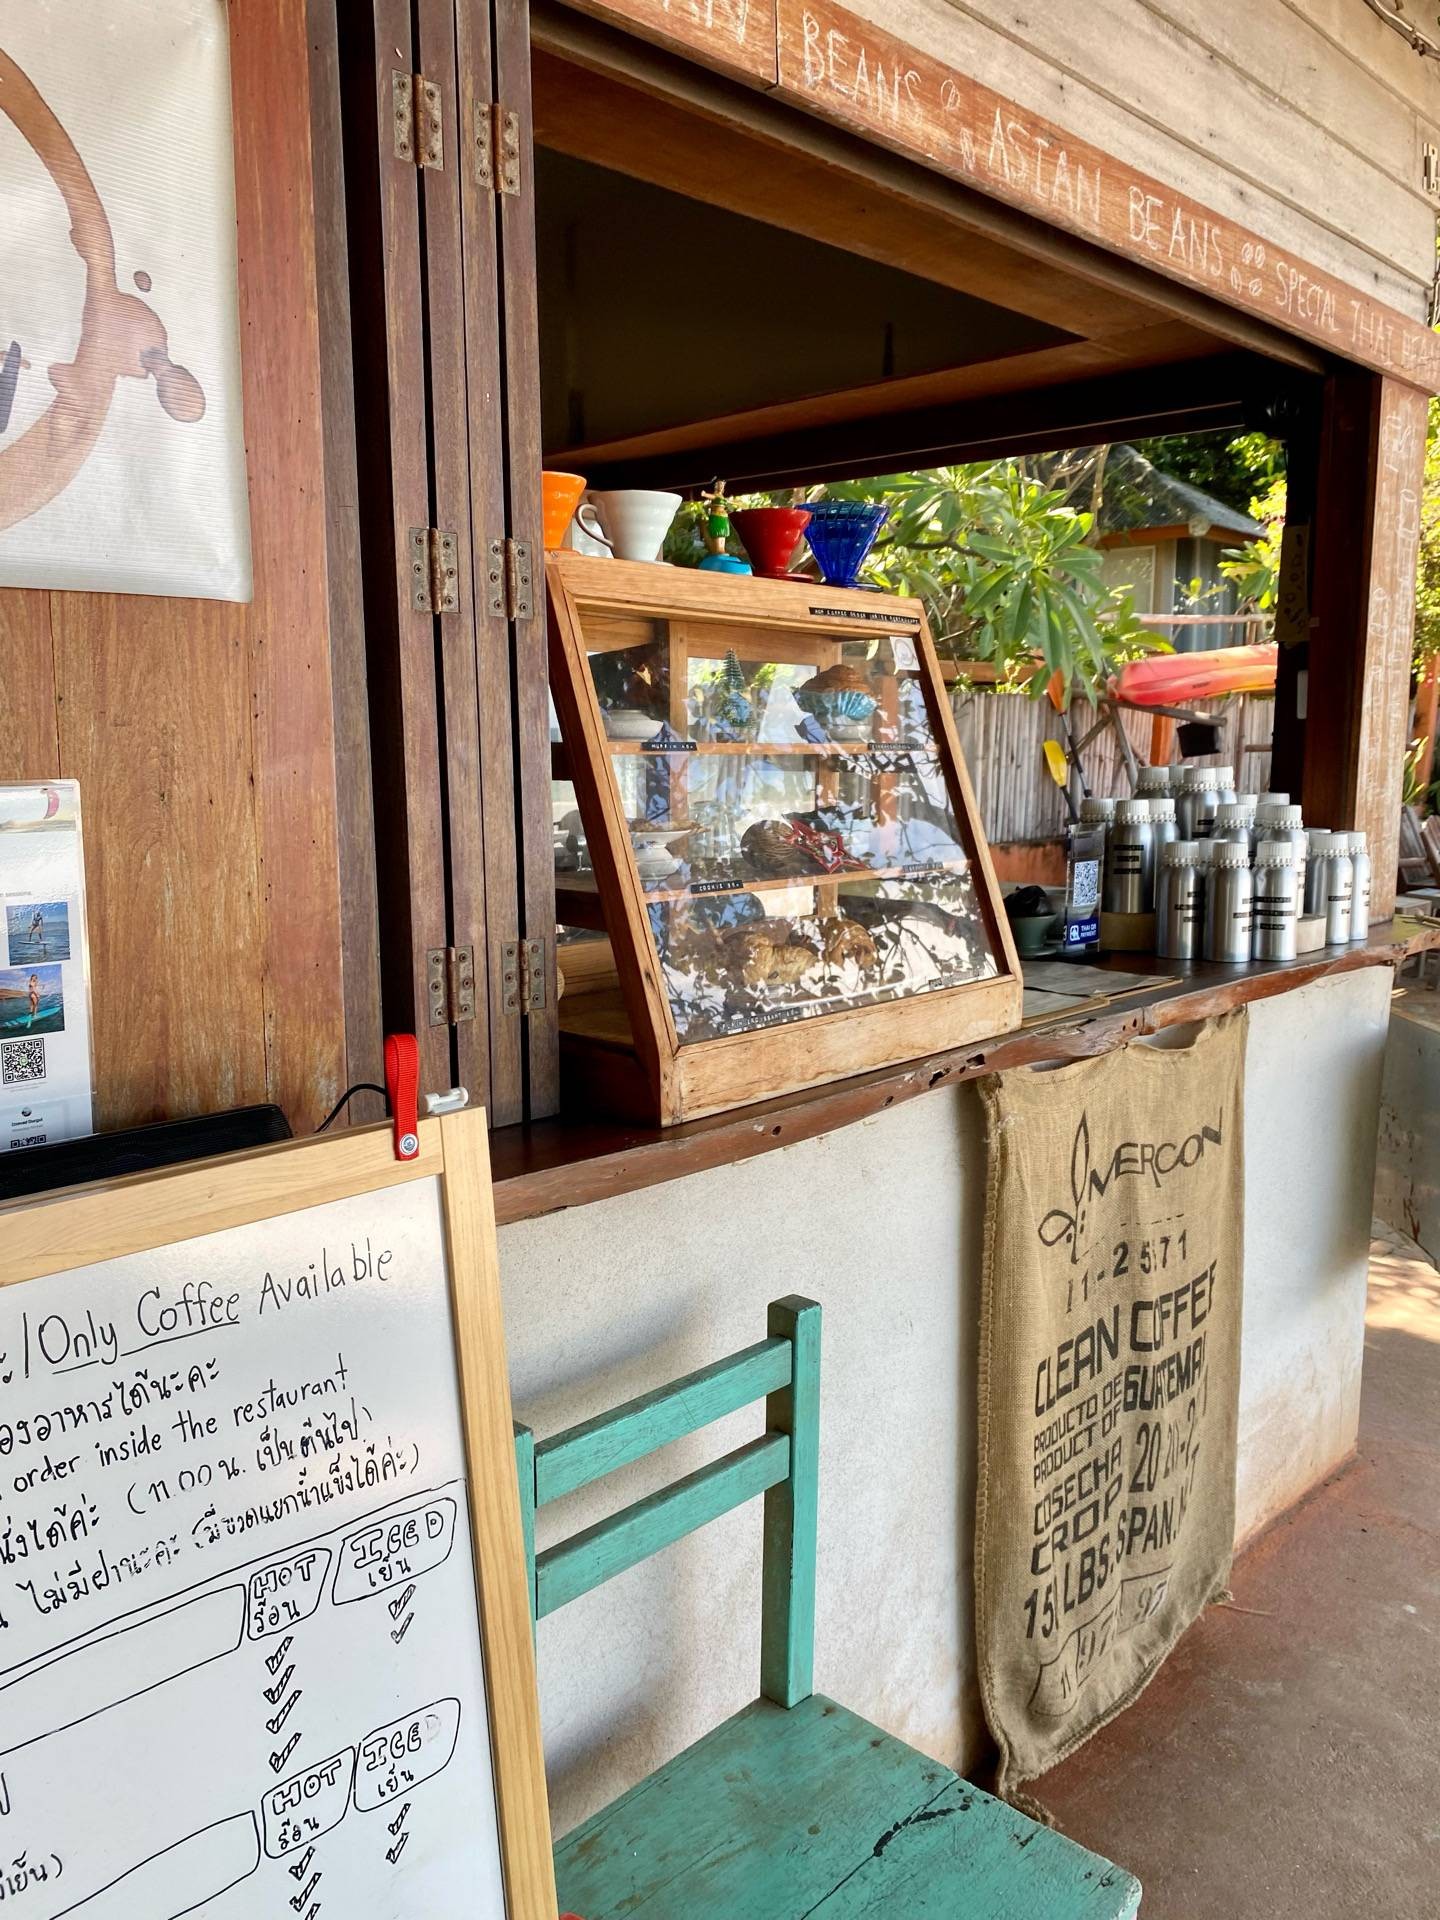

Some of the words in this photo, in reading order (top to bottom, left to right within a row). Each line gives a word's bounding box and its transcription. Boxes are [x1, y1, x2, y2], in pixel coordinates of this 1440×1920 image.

[803, 8, 923, 126] BEANS
[1128, 186, 1223, 277] BEANS
[1275, 261, 1340, 332] SPECIAL
[137, 1281, 240, 1338] Coffee
[259, 1238, 393, 1315] Available
[1035, 1304, 1119, 1417] CLEAN
[14, 1455, 81, 1492] order
[94, 1424, 162, 1467] inside
[171, 1409, 218, 1443] the
[233, 1353, 348, 1427] restaurant
[1034, 1393, 1098, 1460] PRODUCTO
[1102, 1371, 1123, 1409] DE
[1034, 1421, 1098, 1488] PRODUCT
[1102, 1402, 1122, 1438] OF
[1031, 1473, 1123, 1576] CROP
[1034, 1435, 1122, 1536] COSECHA
[254, 1553, 316, 1600] HOT
[350, 1510, 444, 1570] ICED
[272, 1758, 342, 1815] HOT
